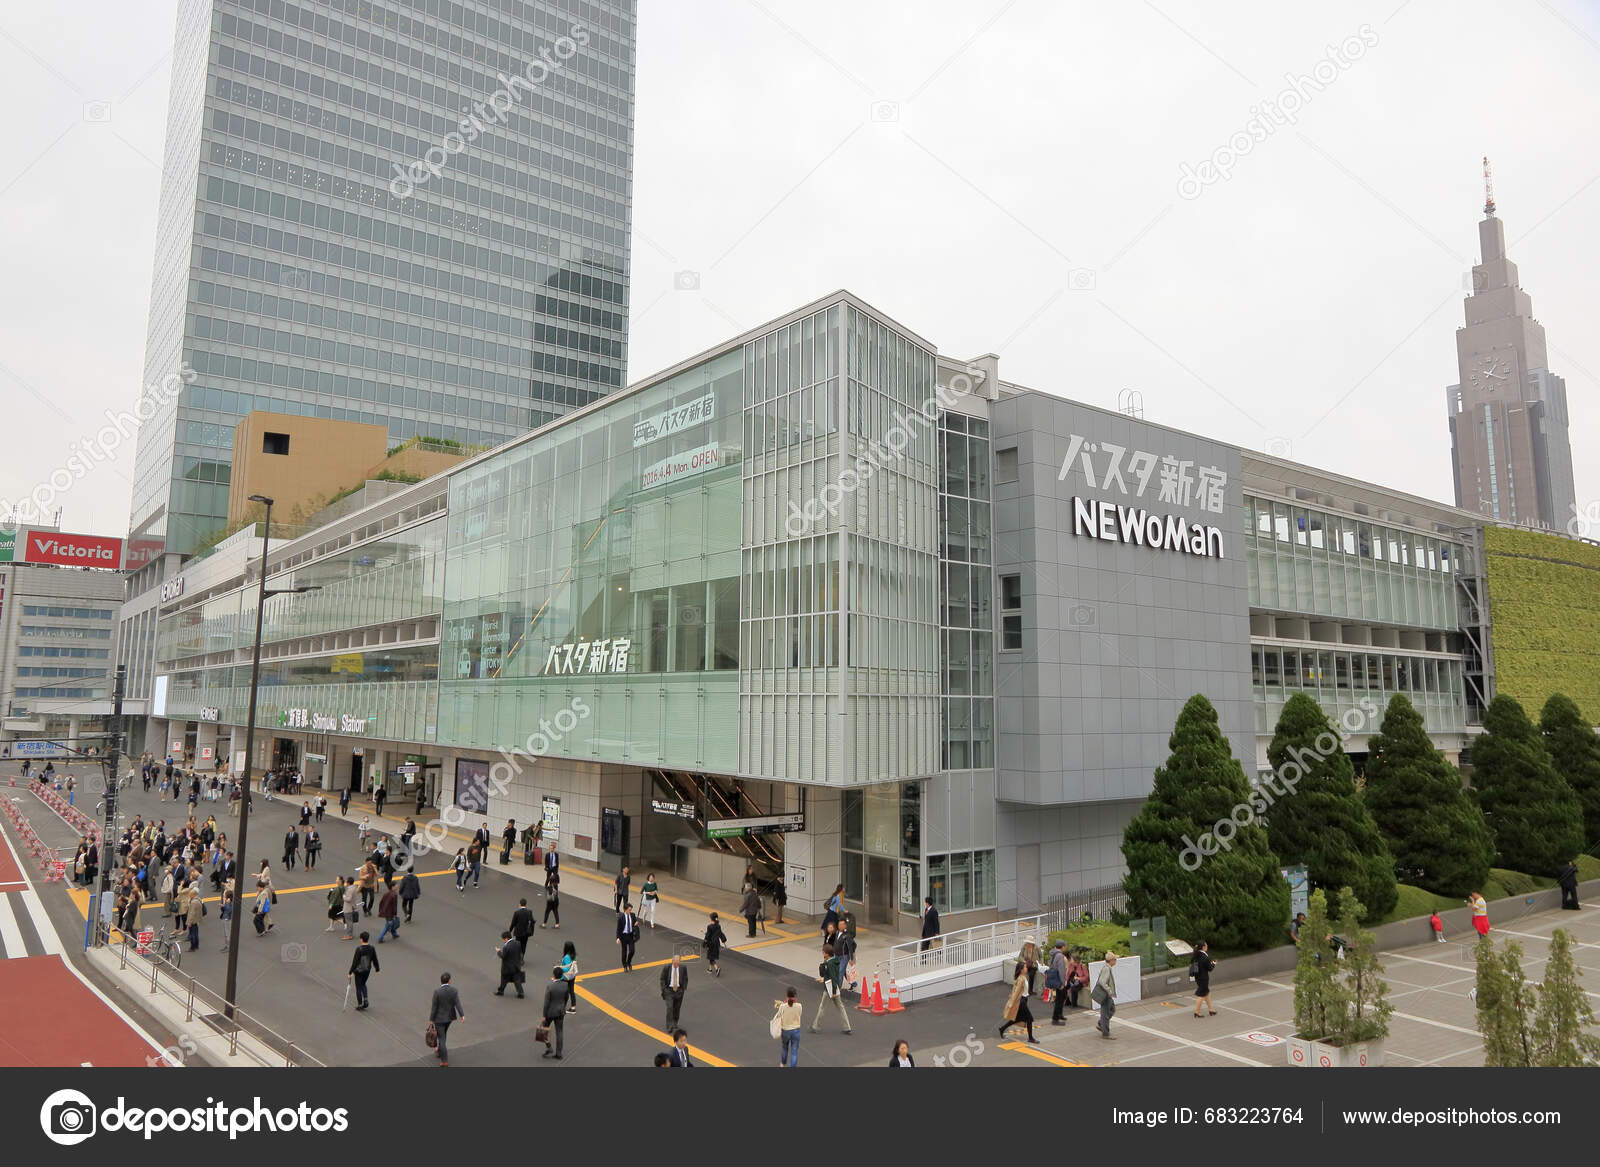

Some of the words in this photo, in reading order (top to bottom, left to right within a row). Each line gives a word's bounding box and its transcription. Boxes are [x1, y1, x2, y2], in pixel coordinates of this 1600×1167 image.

[660, 397, 714, 433] バスタ新宿
[691, 448, 719, 469] OPEN
[1057, 434, 1228, 514] バスタ新宿
[1072, 496, 1225, 559] NEWoMan
[34, 538, 114, 560] Victoria
[544, 637, 630, 674] バスタ新宿
[341, 712, 366, 733] Station
